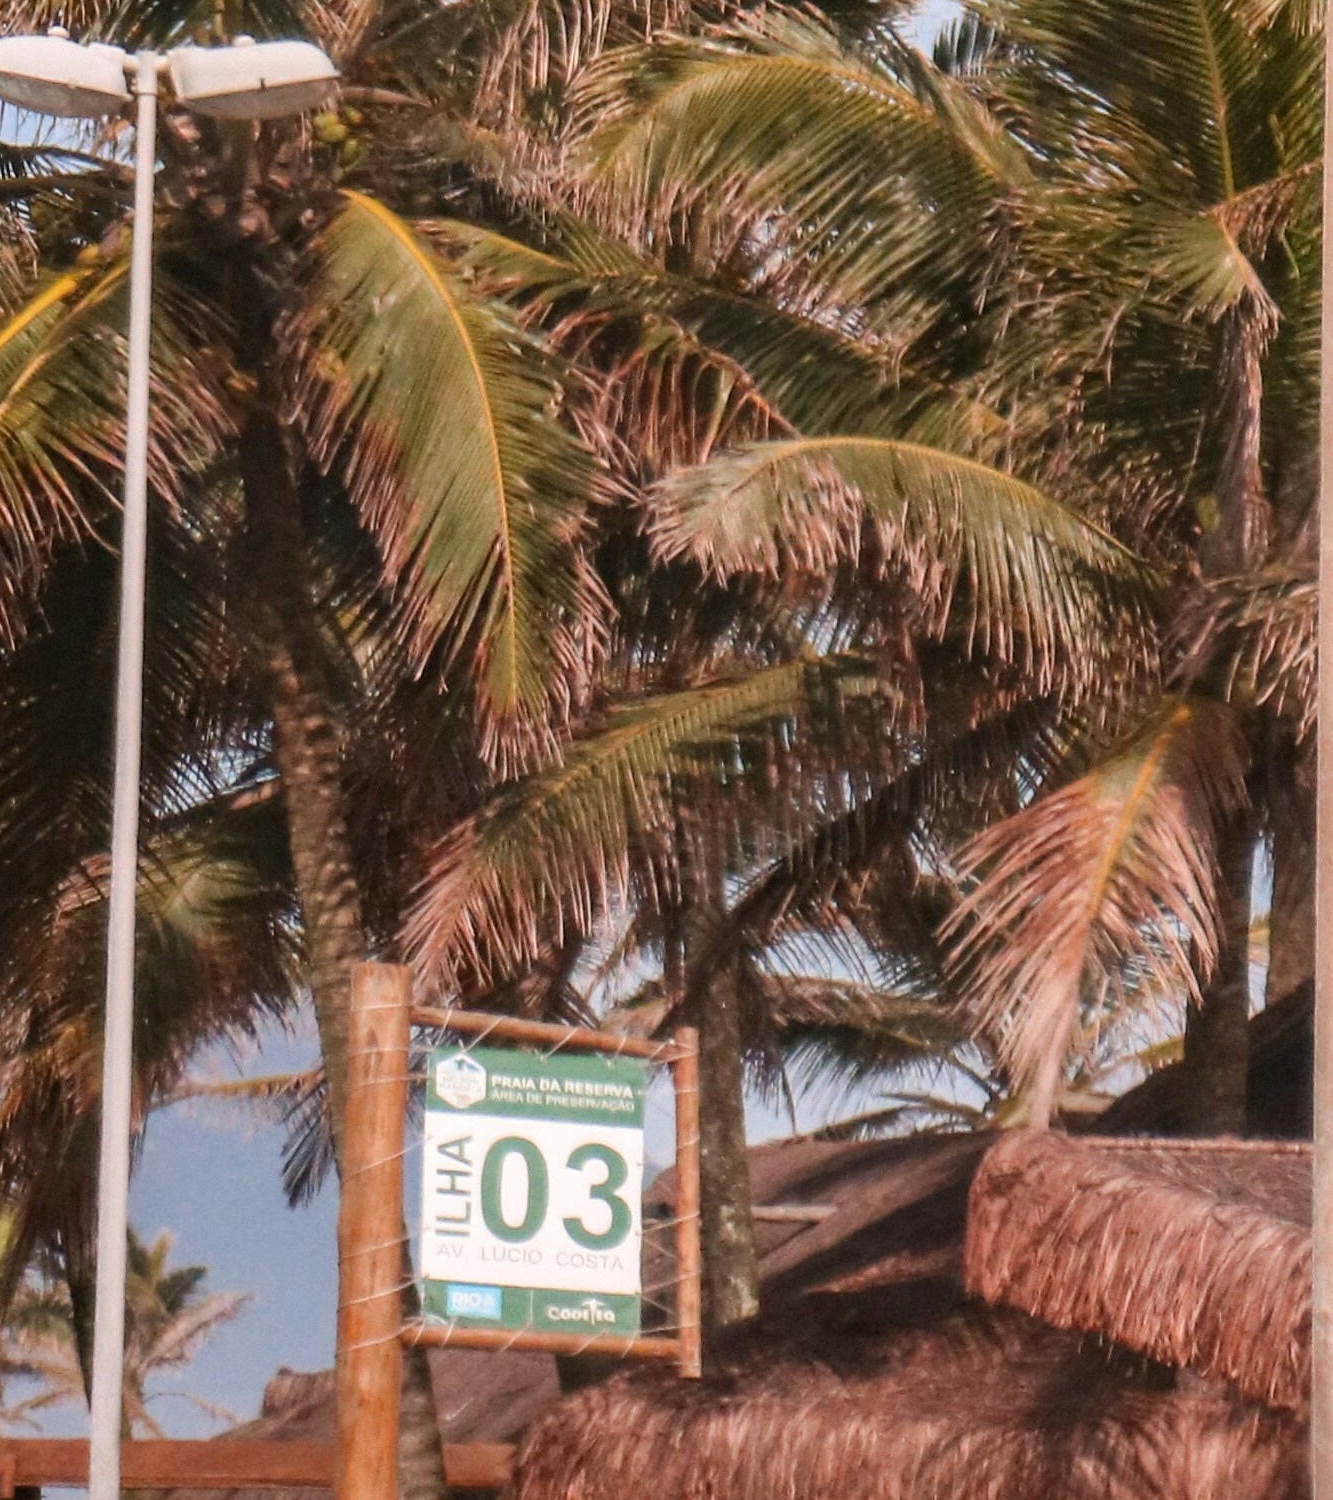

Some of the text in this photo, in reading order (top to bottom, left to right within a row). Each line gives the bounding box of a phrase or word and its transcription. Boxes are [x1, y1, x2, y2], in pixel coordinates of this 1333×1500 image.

[491, 1074, 633, 1099] PRAIA DA RESERVA
[526, 1093, 544, 1105] DE
[435, 1136, 472, 1237] ILHA
[480, 1136, 633, 1251] 03
[555, 1251, 625, 1273] COSTA
